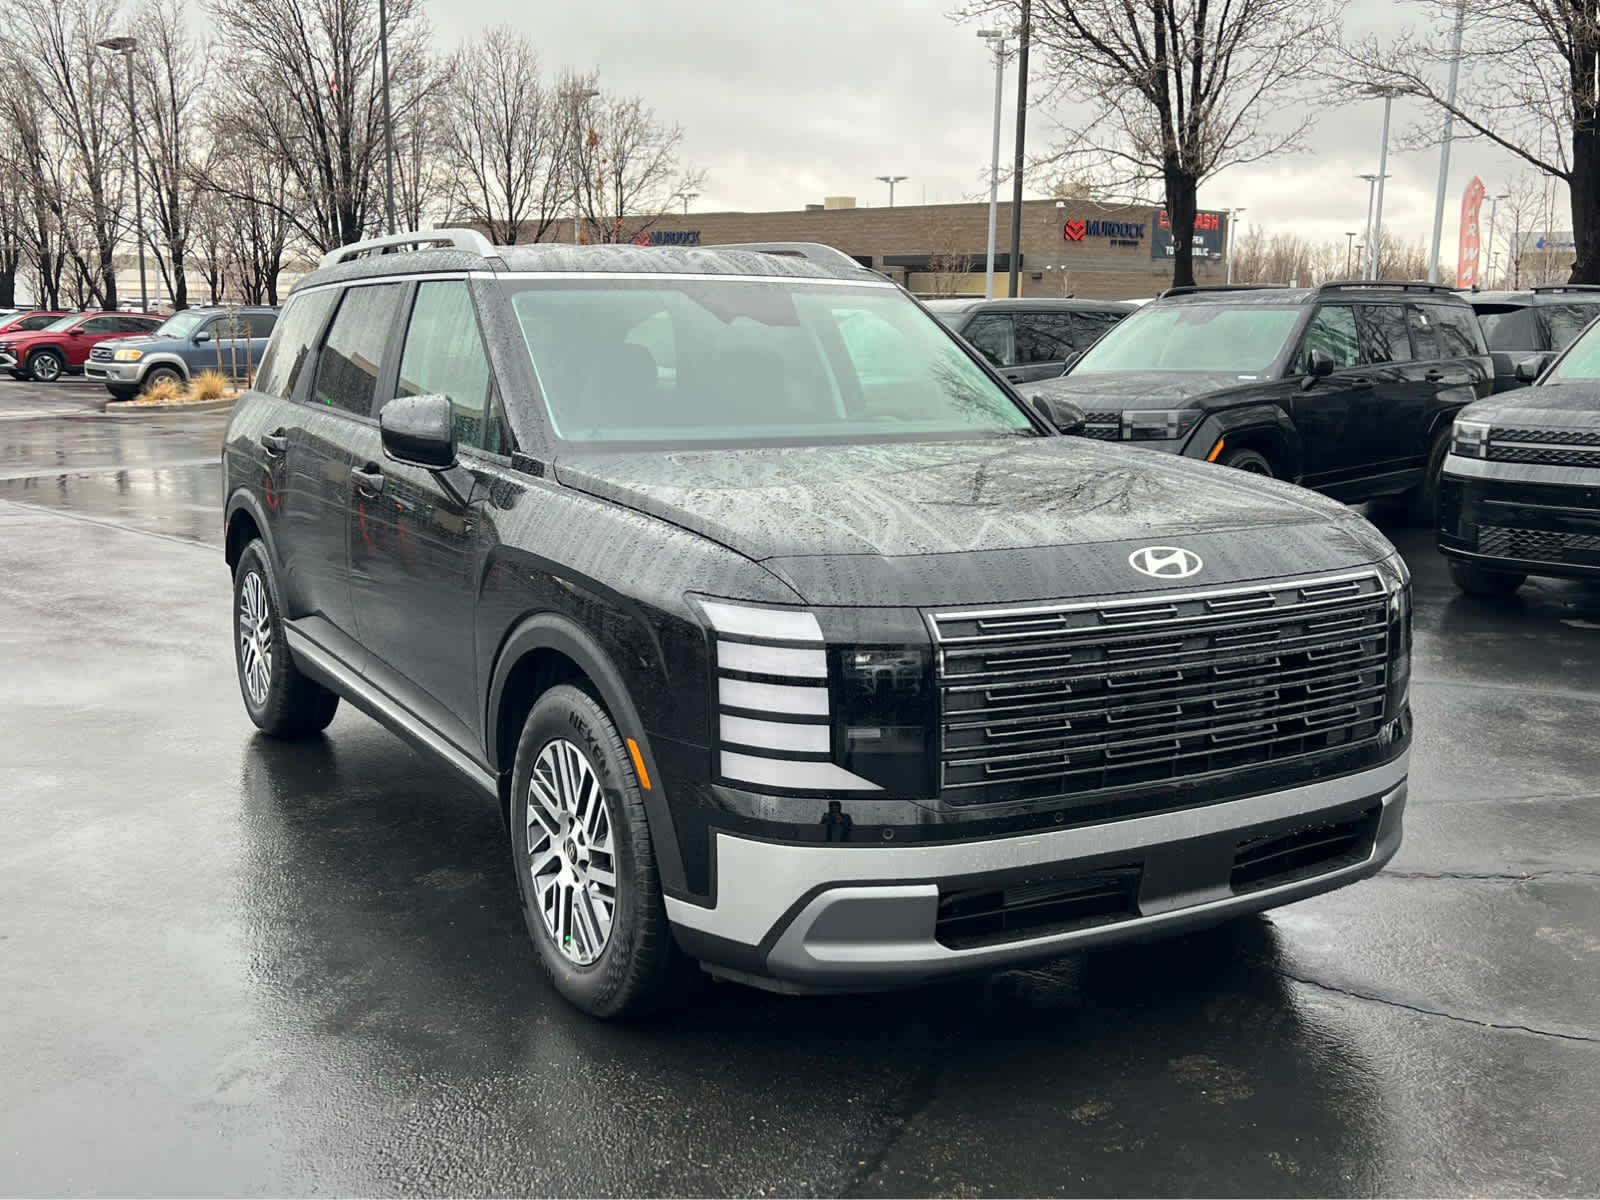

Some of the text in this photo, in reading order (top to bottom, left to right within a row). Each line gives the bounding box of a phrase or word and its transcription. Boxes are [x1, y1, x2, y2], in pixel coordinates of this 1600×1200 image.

[1086, 219, 1145, 239] MURDOCK
[1159, 210, 1219, 231] CASH
[568, 711, 611, 777] NEXEN
